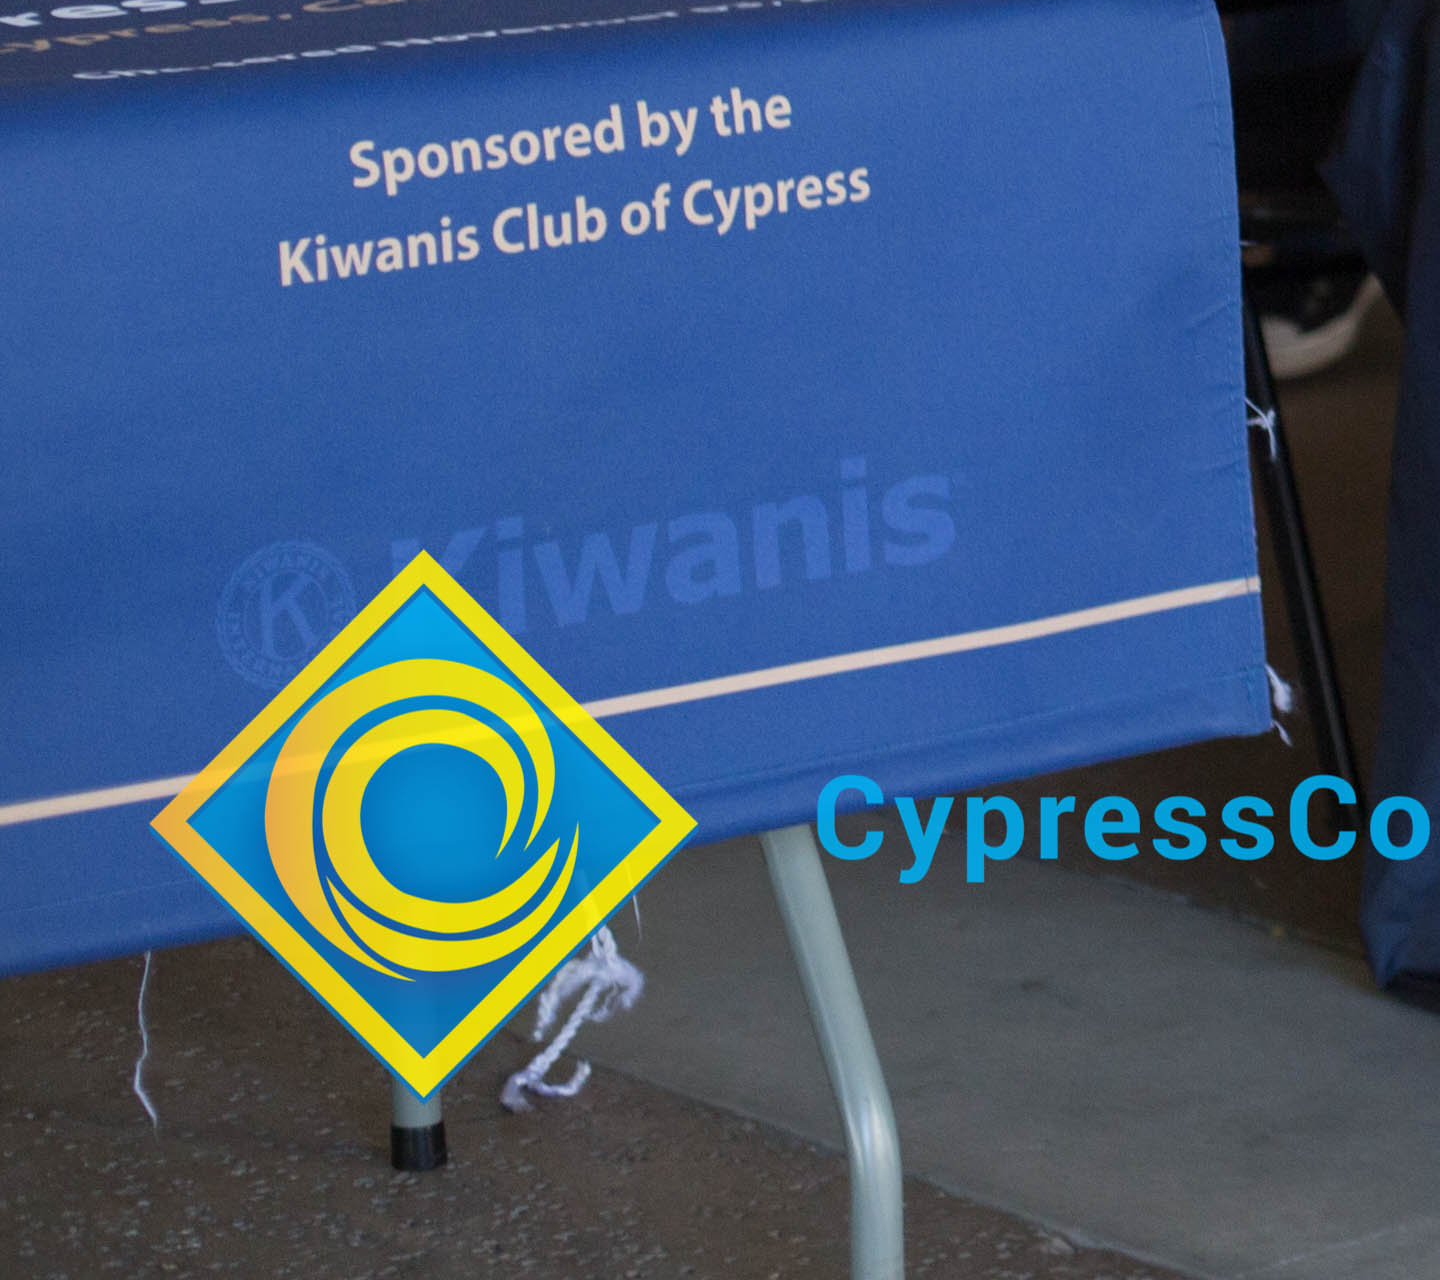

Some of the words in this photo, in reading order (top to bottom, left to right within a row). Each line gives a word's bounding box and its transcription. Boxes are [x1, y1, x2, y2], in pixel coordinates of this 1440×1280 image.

[349, 103, 625, 197] Sponsored
[636, 99, 699, 157] by
[710, 86, 793, 137] the
[279, 216, 480, 288] Kiwanis
[492, 194, 608, 254] Club
[620, 183, 671, 236] of
[682, 167, 871, 236] Cypress
